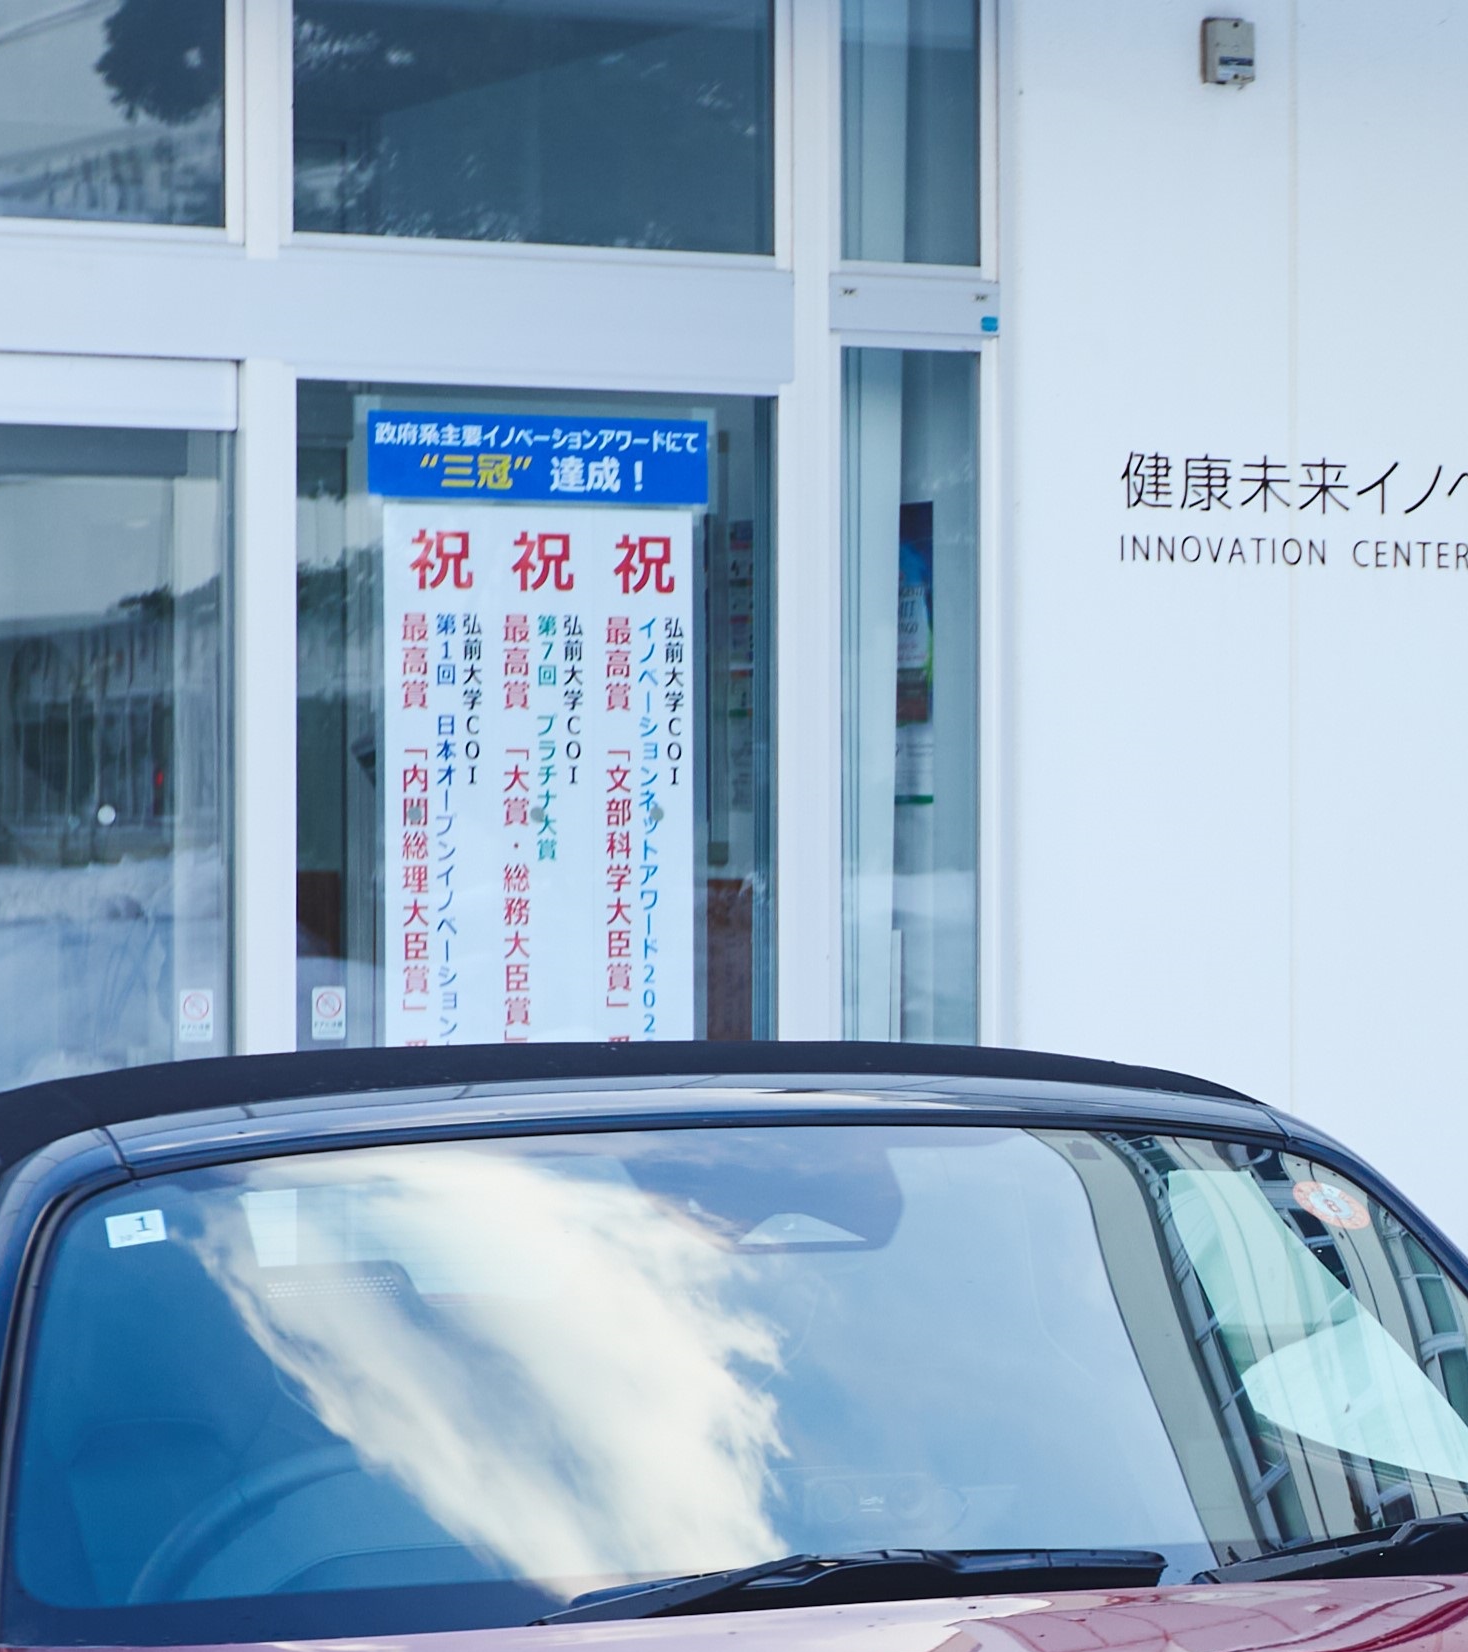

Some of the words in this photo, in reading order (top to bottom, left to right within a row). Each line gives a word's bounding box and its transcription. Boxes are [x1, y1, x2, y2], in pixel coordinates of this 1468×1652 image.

[375, 422, 700, 453] 政府系主要イノベーションアワードにて
[410, 528, 474, 592] 祝
[511, 530, 575, 593] 祝
[613, 533, 676, 596] 祝
[1120, 534, 1327, 567] INNOVATION
[401, 611, 430, 711] 最高賞
[436, 613, 457, 687] 第1回
[462, 613, 483, 786] 弘前大学COI
[503, 612, 531, 711] 最高賞
[537, 614, 558, 688] 第7回
[605, 614, 632, 712] 最高賞
[563, 614, 584, 786] 弘前大学COI
[664, 616, 685, 786] 弘前大学COI
[536, 714, 558, 862] プラチナ大賞
[637, 616, 660, 1041] イノベーションネットアワード202
[435, 713, 458, 1044] 日本オープンイノベーション
[503, 748, 531, 1043] 「大賞・総務大臣賞」
[605, 750, 632, 1009] 「文部科学大臣賞」
[135, 1216, 152, 1232] 1
